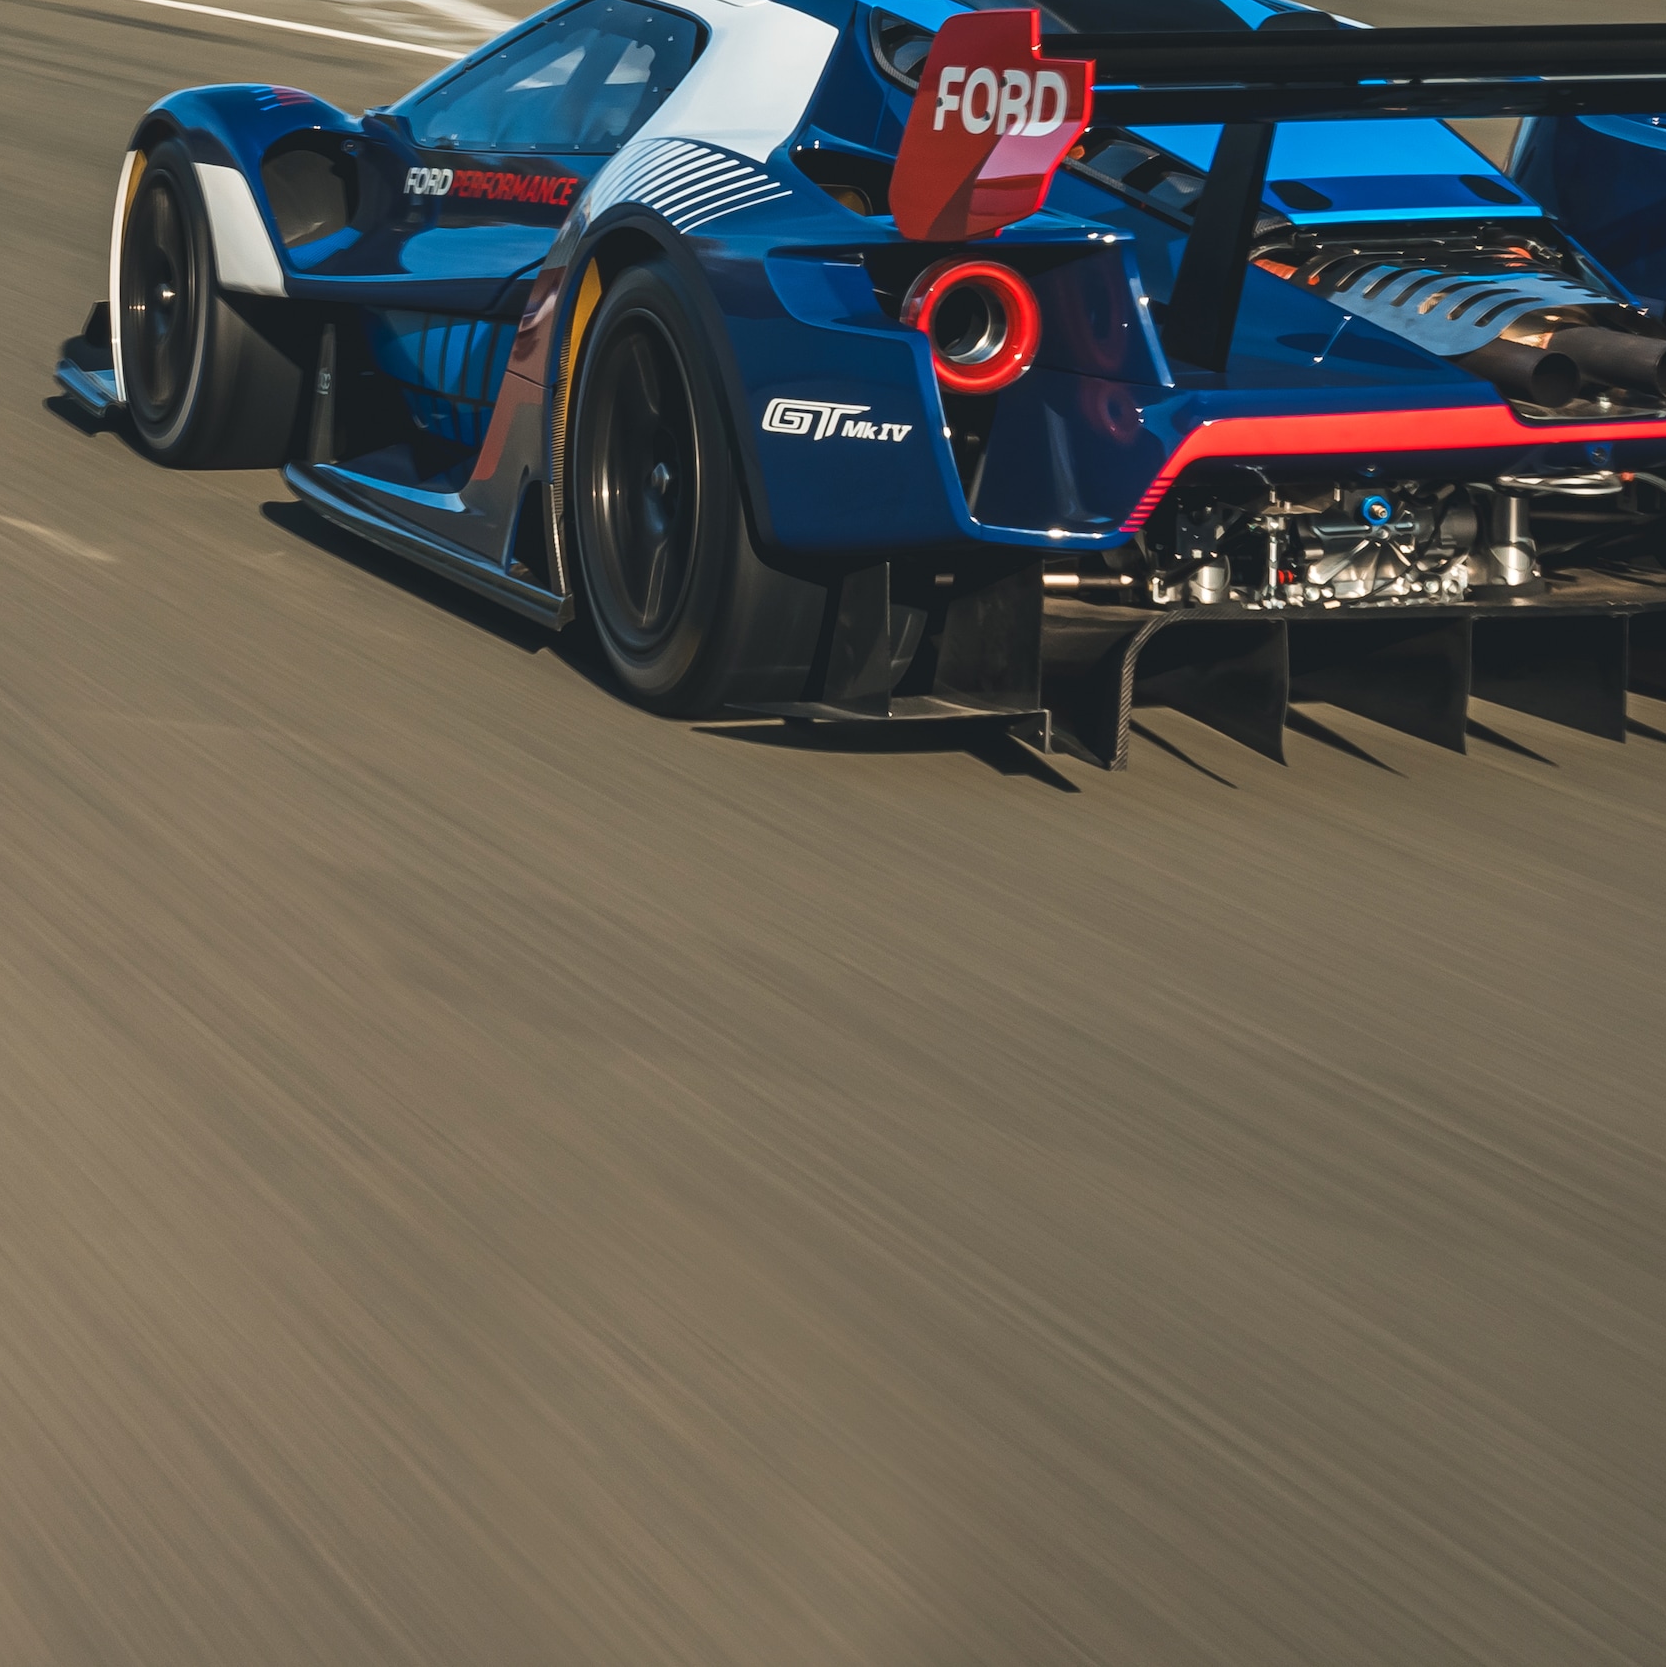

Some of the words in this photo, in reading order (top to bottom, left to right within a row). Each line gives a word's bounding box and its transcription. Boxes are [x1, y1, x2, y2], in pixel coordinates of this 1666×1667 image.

[933, 67, 1067, 136] FORD
[404, 167, 453, 196] FORD
[449, 170, 578, 206] PERFORMANCE
[762, 398, 871, 441] GT
